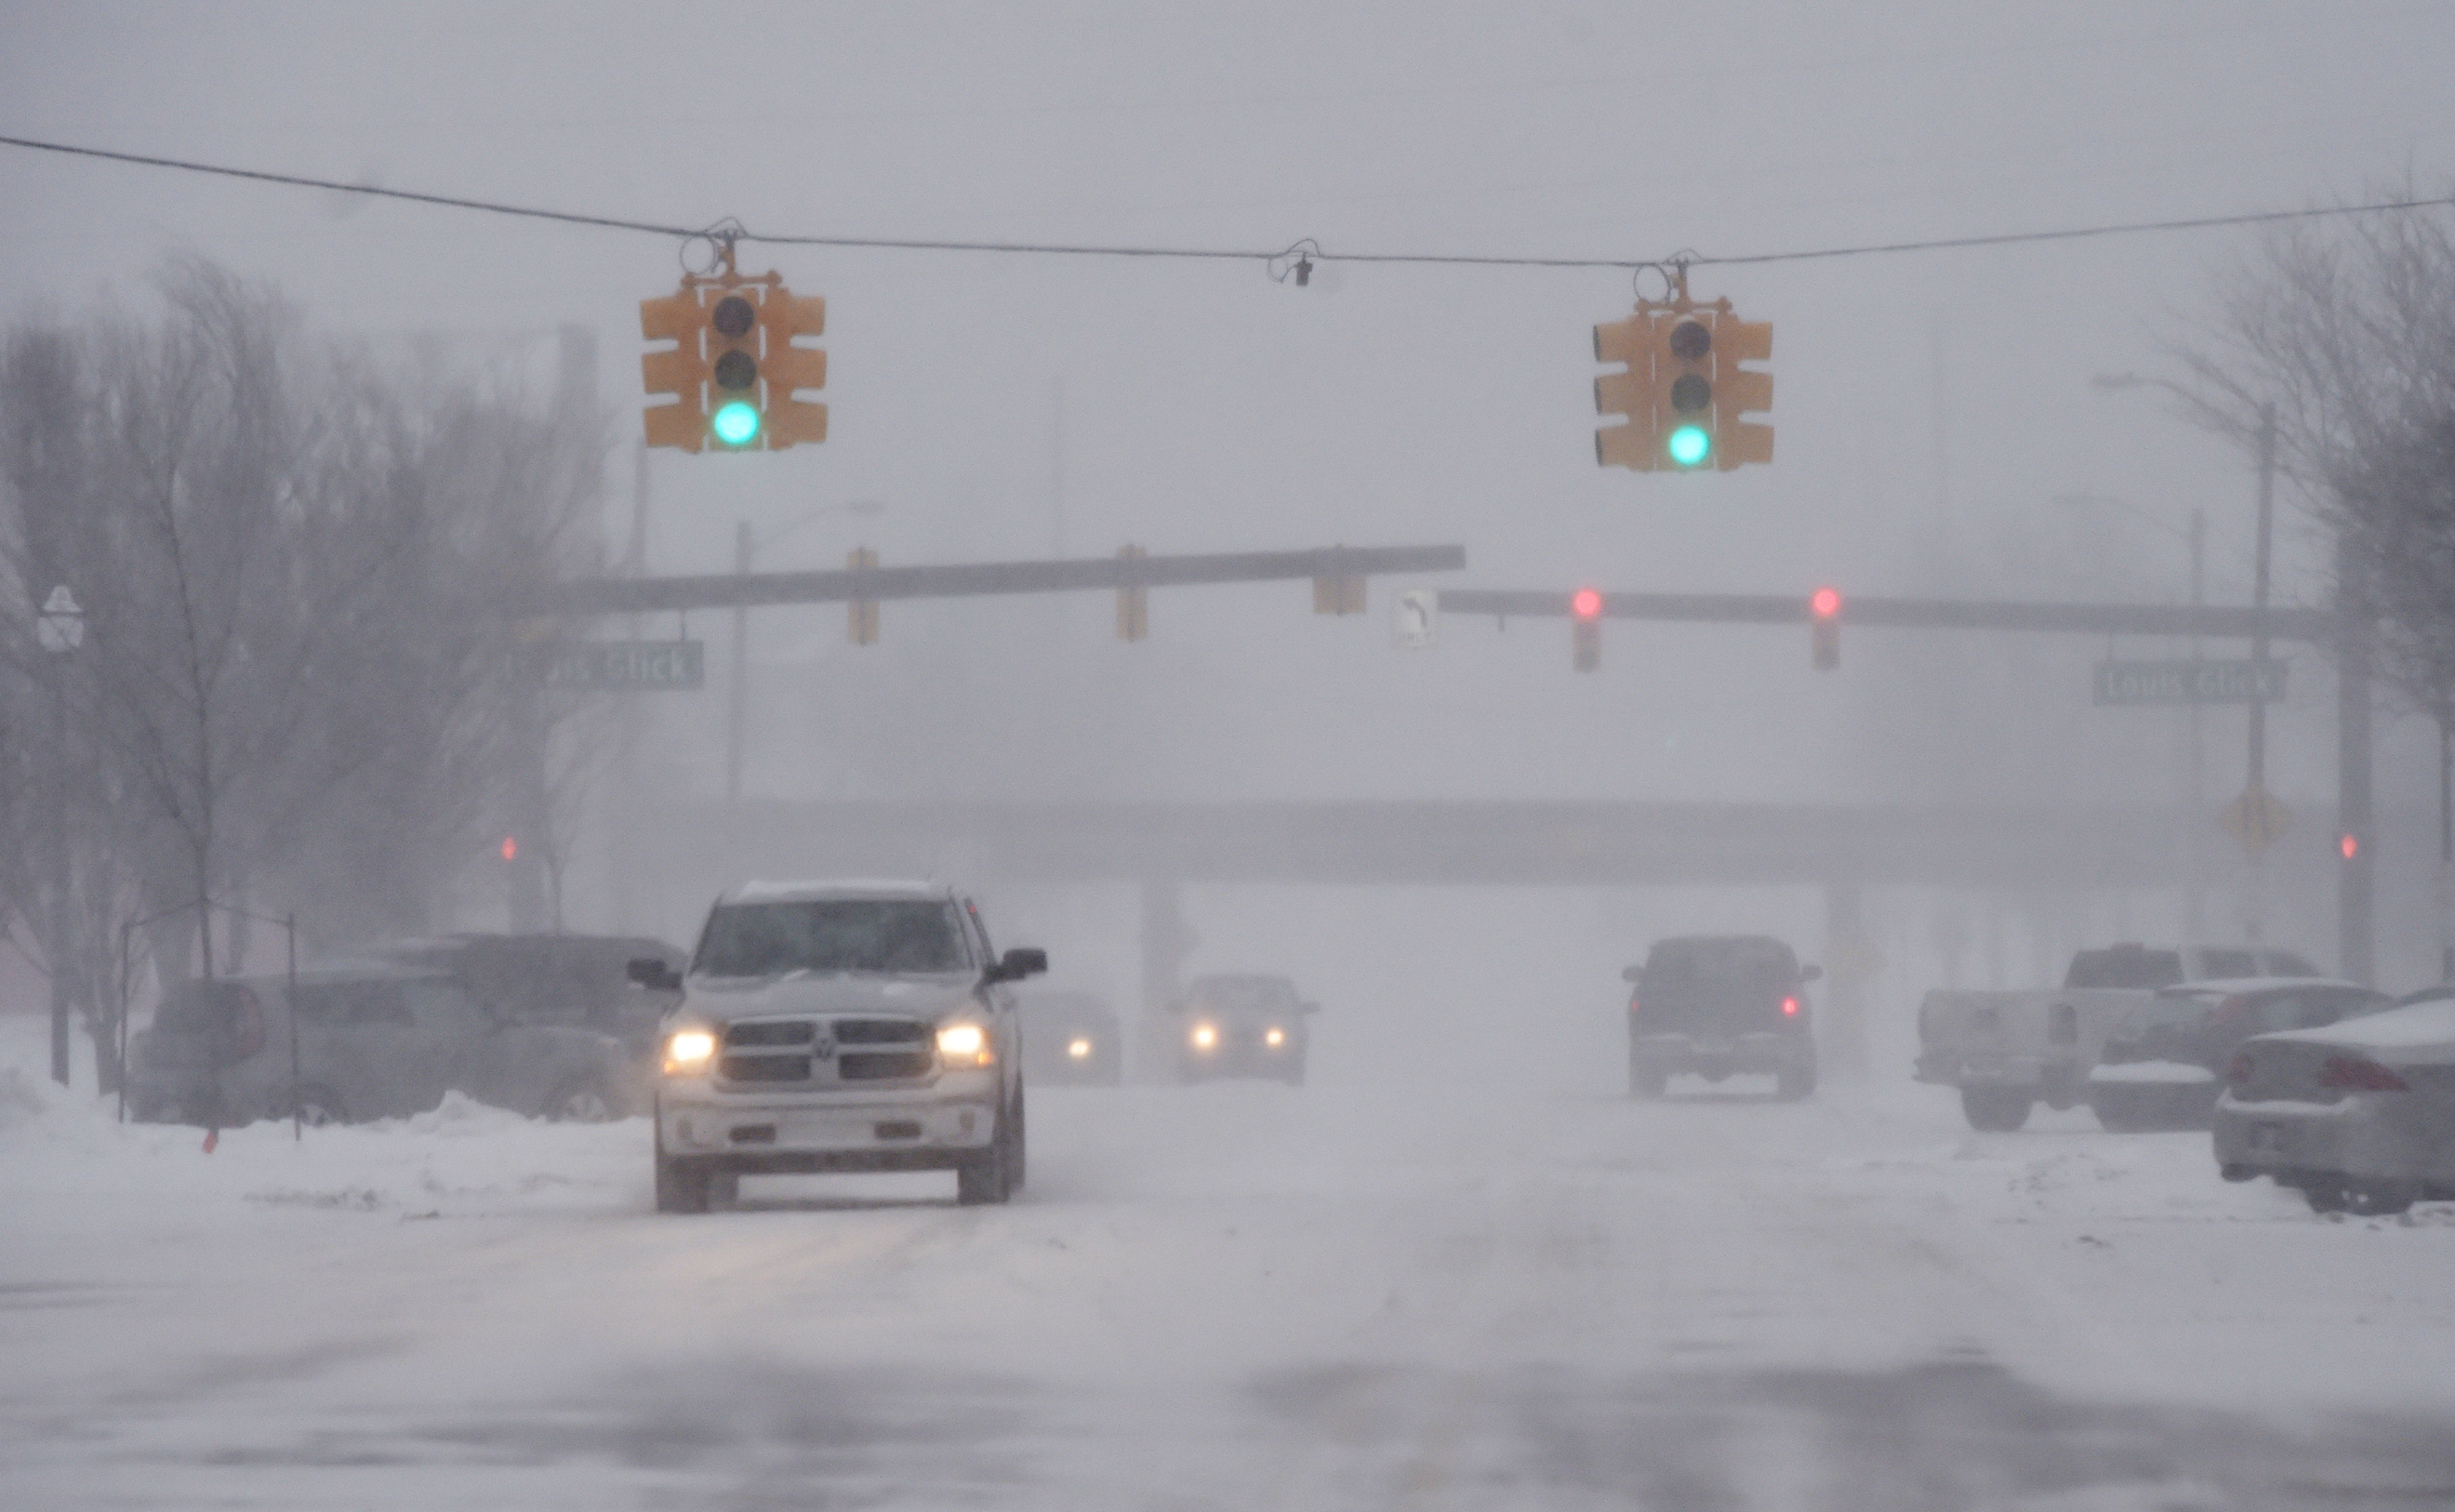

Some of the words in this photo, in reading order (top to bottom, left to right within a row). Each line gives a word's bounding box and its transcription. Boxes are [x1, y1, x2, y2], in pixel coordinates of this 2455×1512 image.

[607, 648, 686, 683] Glick
[2106, 670, 2183, 696] Louis
[2197, 664, 2269, 696] Glick
